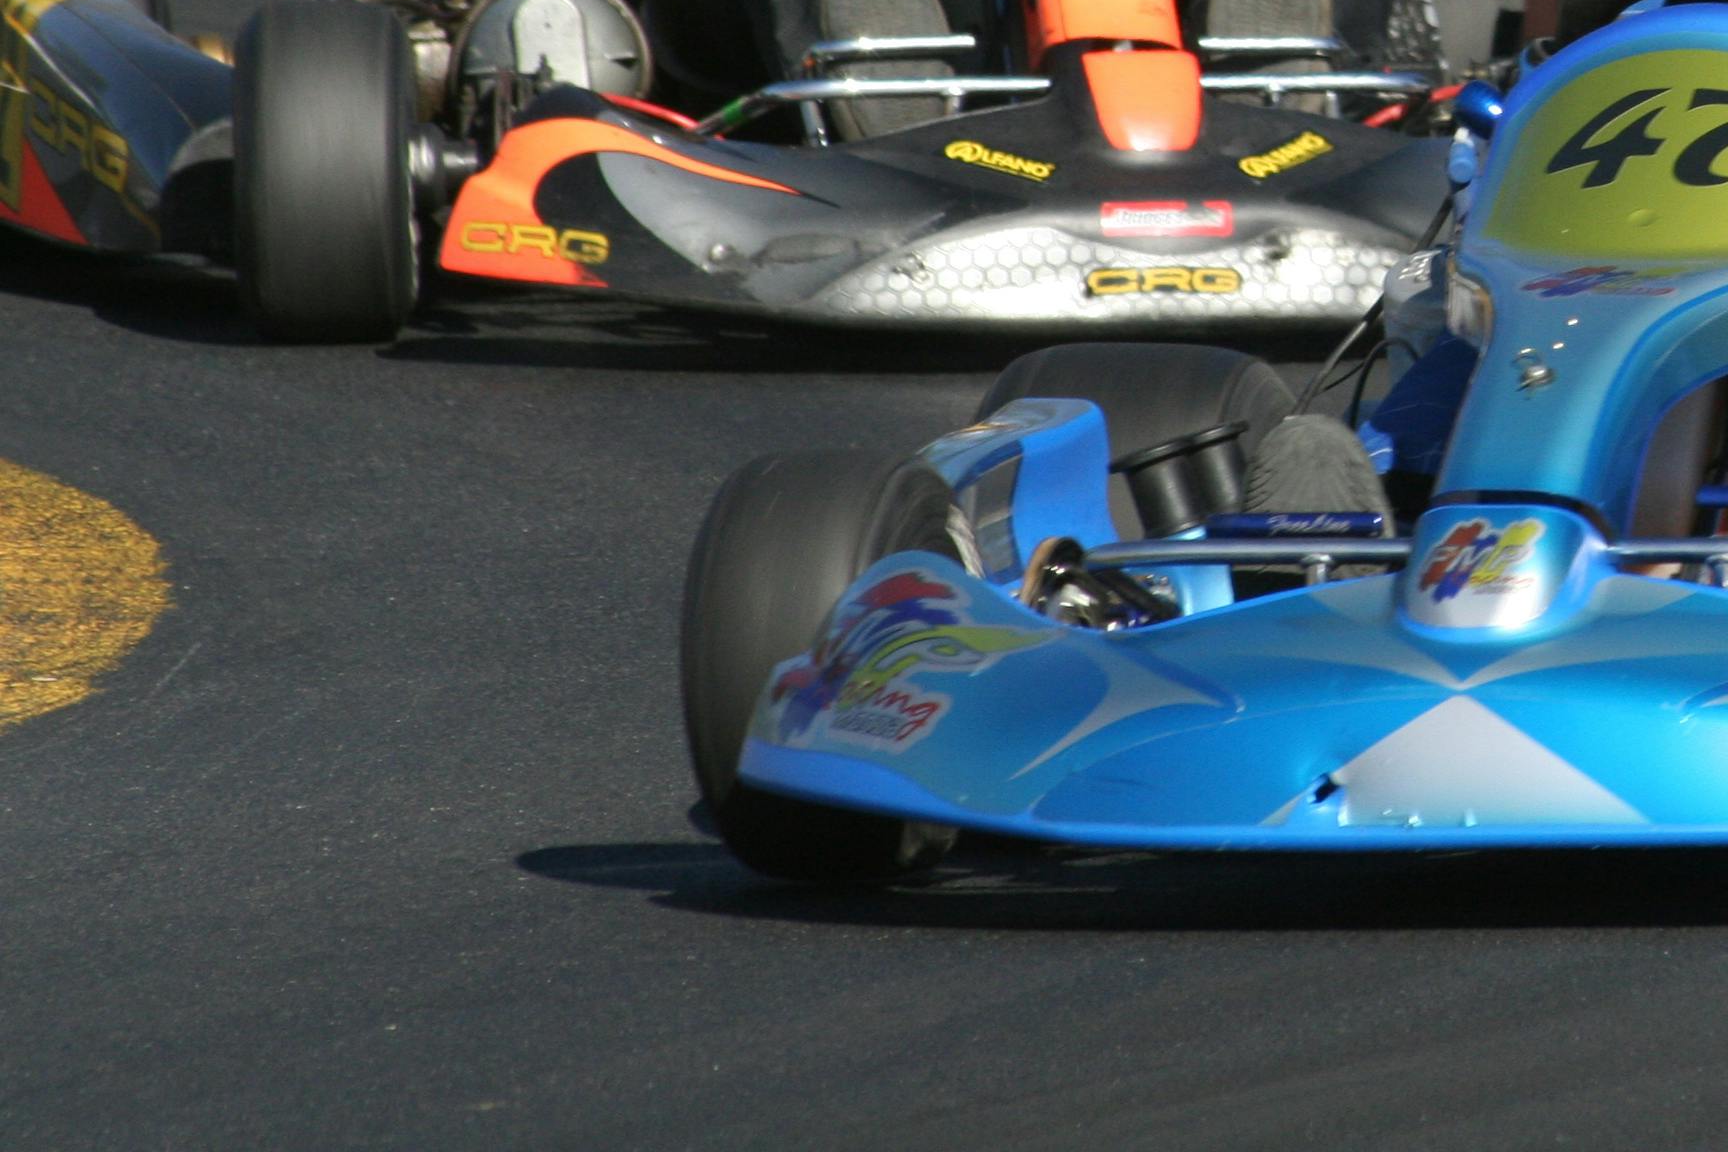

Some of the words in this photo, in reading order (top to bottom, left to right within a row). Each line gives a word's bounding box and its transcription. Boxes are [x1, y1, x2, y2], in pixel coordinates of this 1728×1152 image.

[944, 140, 1051, 179] ALFANO
[461, 221, 610, 265] CRG
[1086, 266, 1243, 297] CRG
